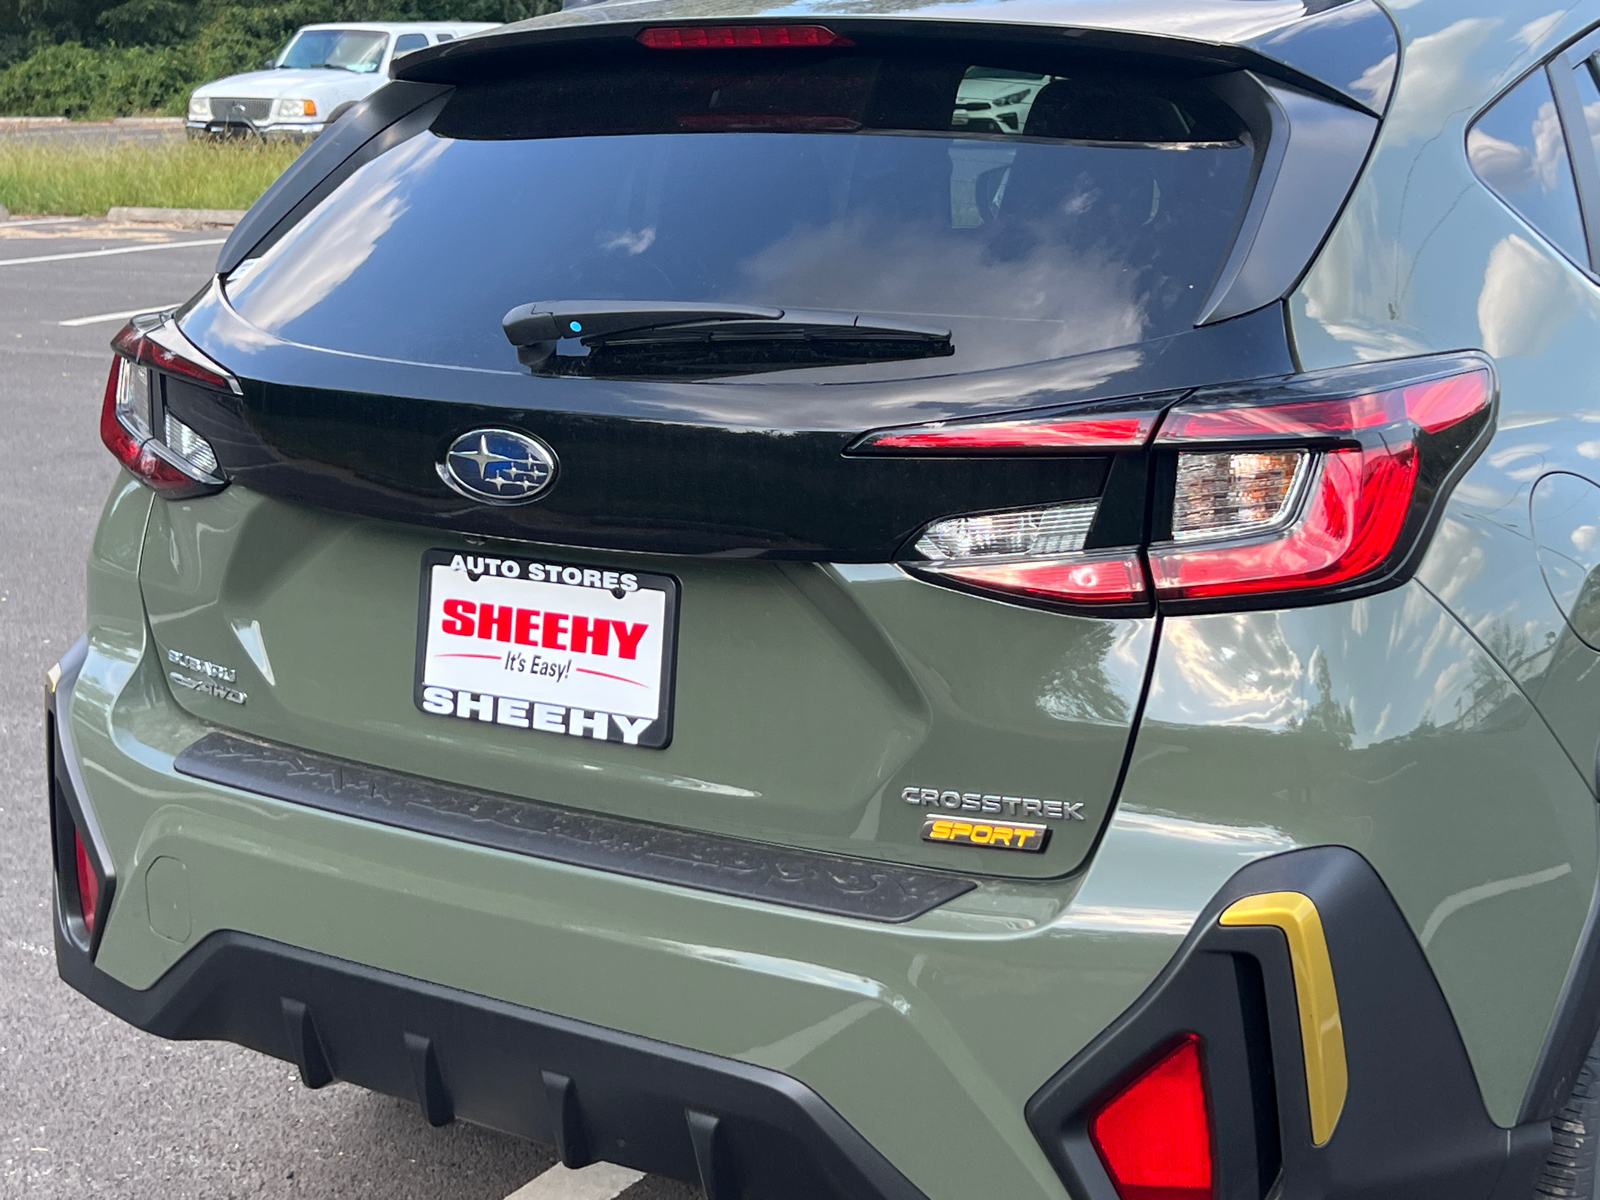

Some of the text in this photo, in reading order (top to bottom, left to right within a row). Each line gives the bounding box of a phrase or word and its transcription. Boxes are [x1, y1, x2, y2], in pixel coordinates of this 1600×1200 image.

[450, 554, 638, 592] AUTO STORES
[441, 598, 649, 660] SHEEHY
[504, 650, 572, 683] It's Easy!
[422, 686, 652, 745] SHEEHY
[901, 787, 1085, 821] CROSSTREK
[929, 820, 1036, 847] SPORT
